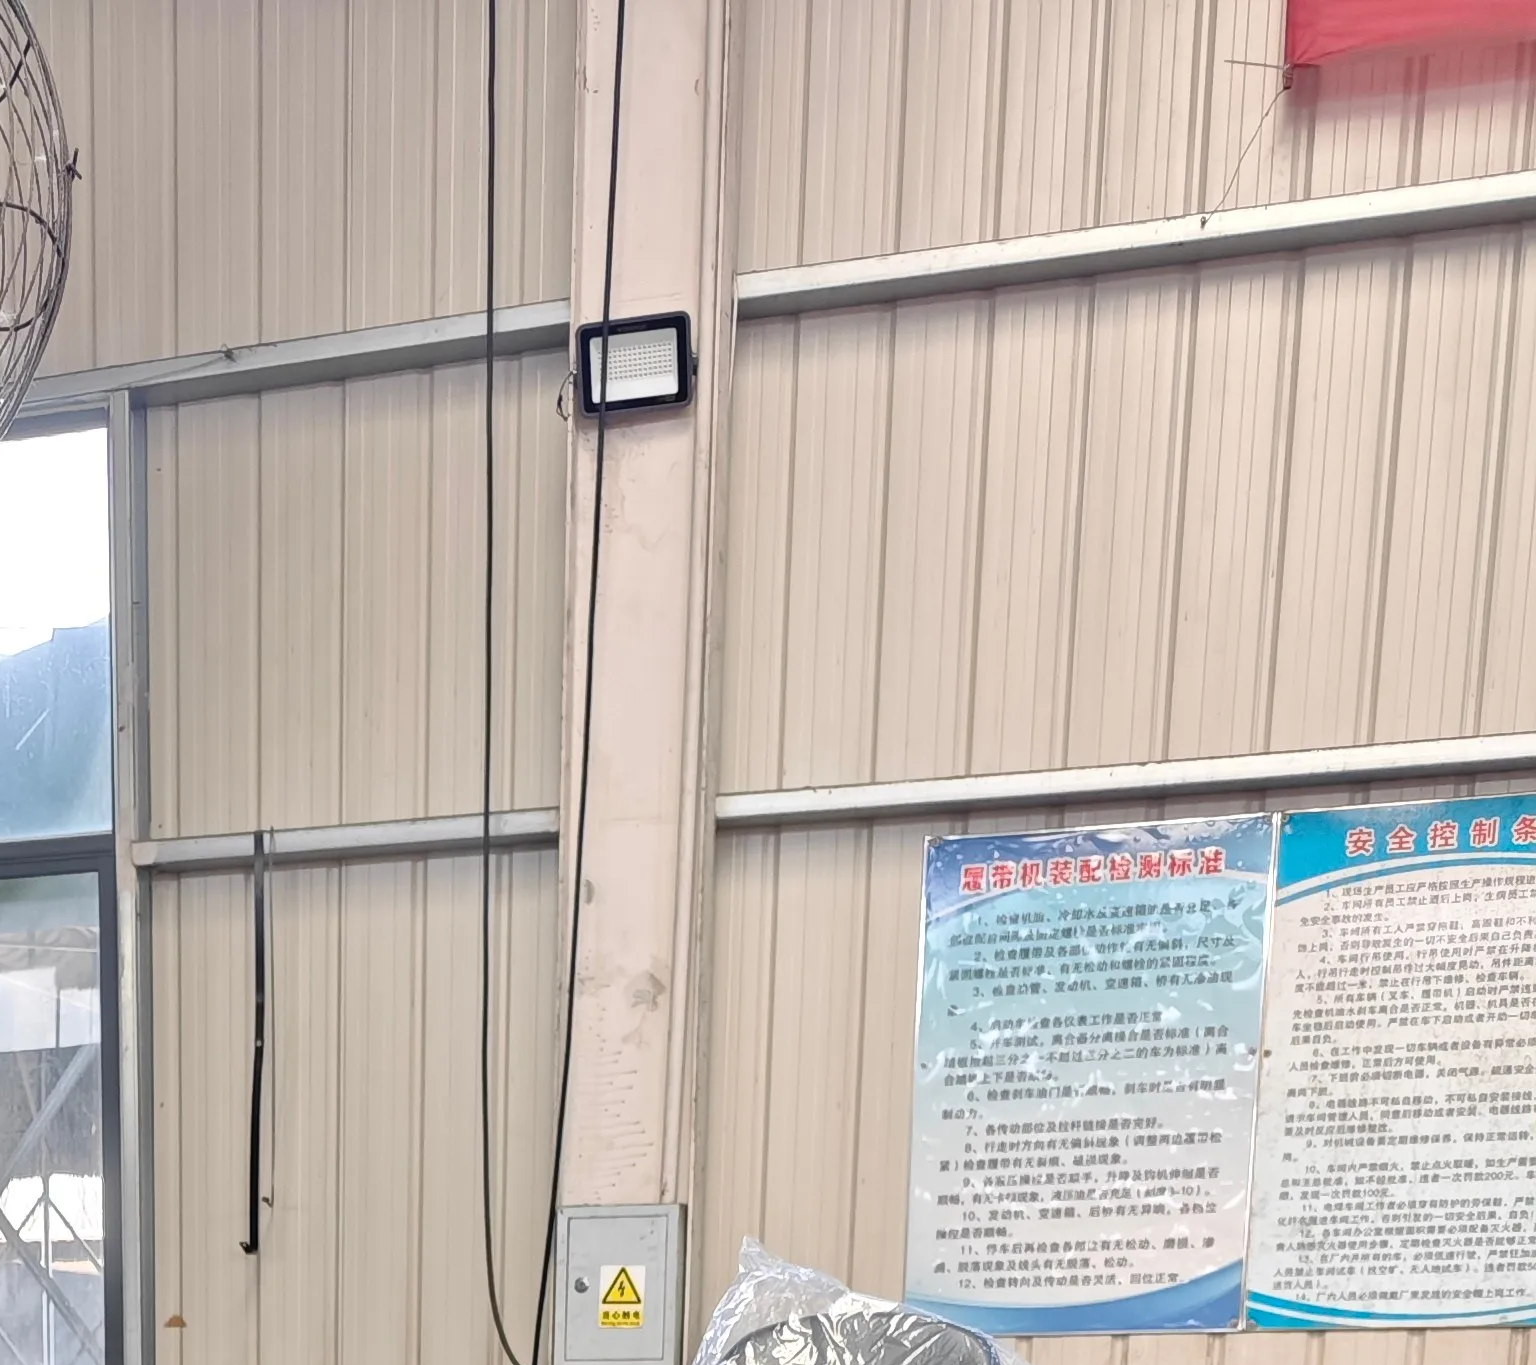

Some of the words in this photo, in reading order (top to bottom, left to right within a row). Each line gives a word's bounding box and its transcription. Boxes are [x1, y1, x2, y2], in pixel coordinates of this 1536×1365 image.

[1348, 816, 1536, 855] 安全控制条
[962, 848, 1225, 892] 履带机装配检测标准
